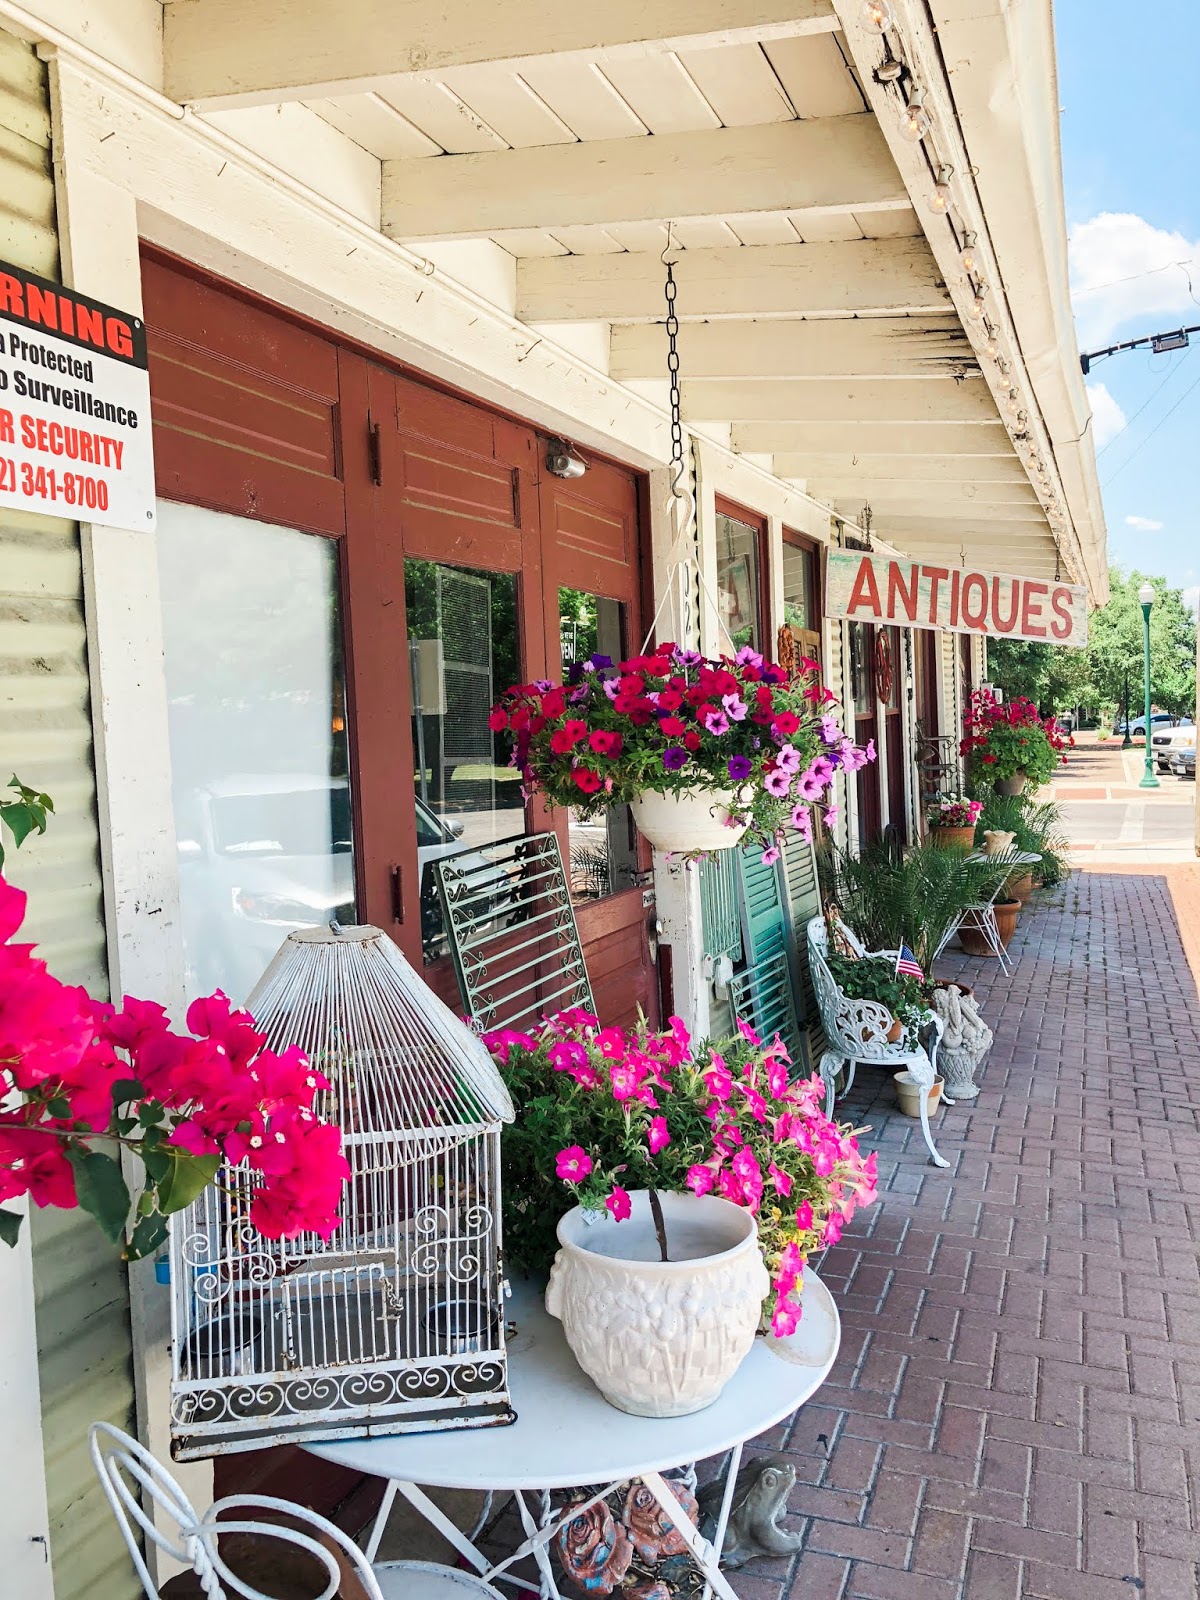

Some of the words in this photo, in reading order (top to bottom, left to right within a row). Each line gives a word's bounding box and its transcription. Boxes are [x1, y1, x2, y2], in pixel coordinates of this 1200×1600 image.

[9, 332, 94, 384] Protected
[13, 370, 138, 430] Surveillance
[20, 414, 124, 471] SECURITY
[21, 462, 109, 512] 341-8700
[846, 556, 1074, 640] ANTIQUES
